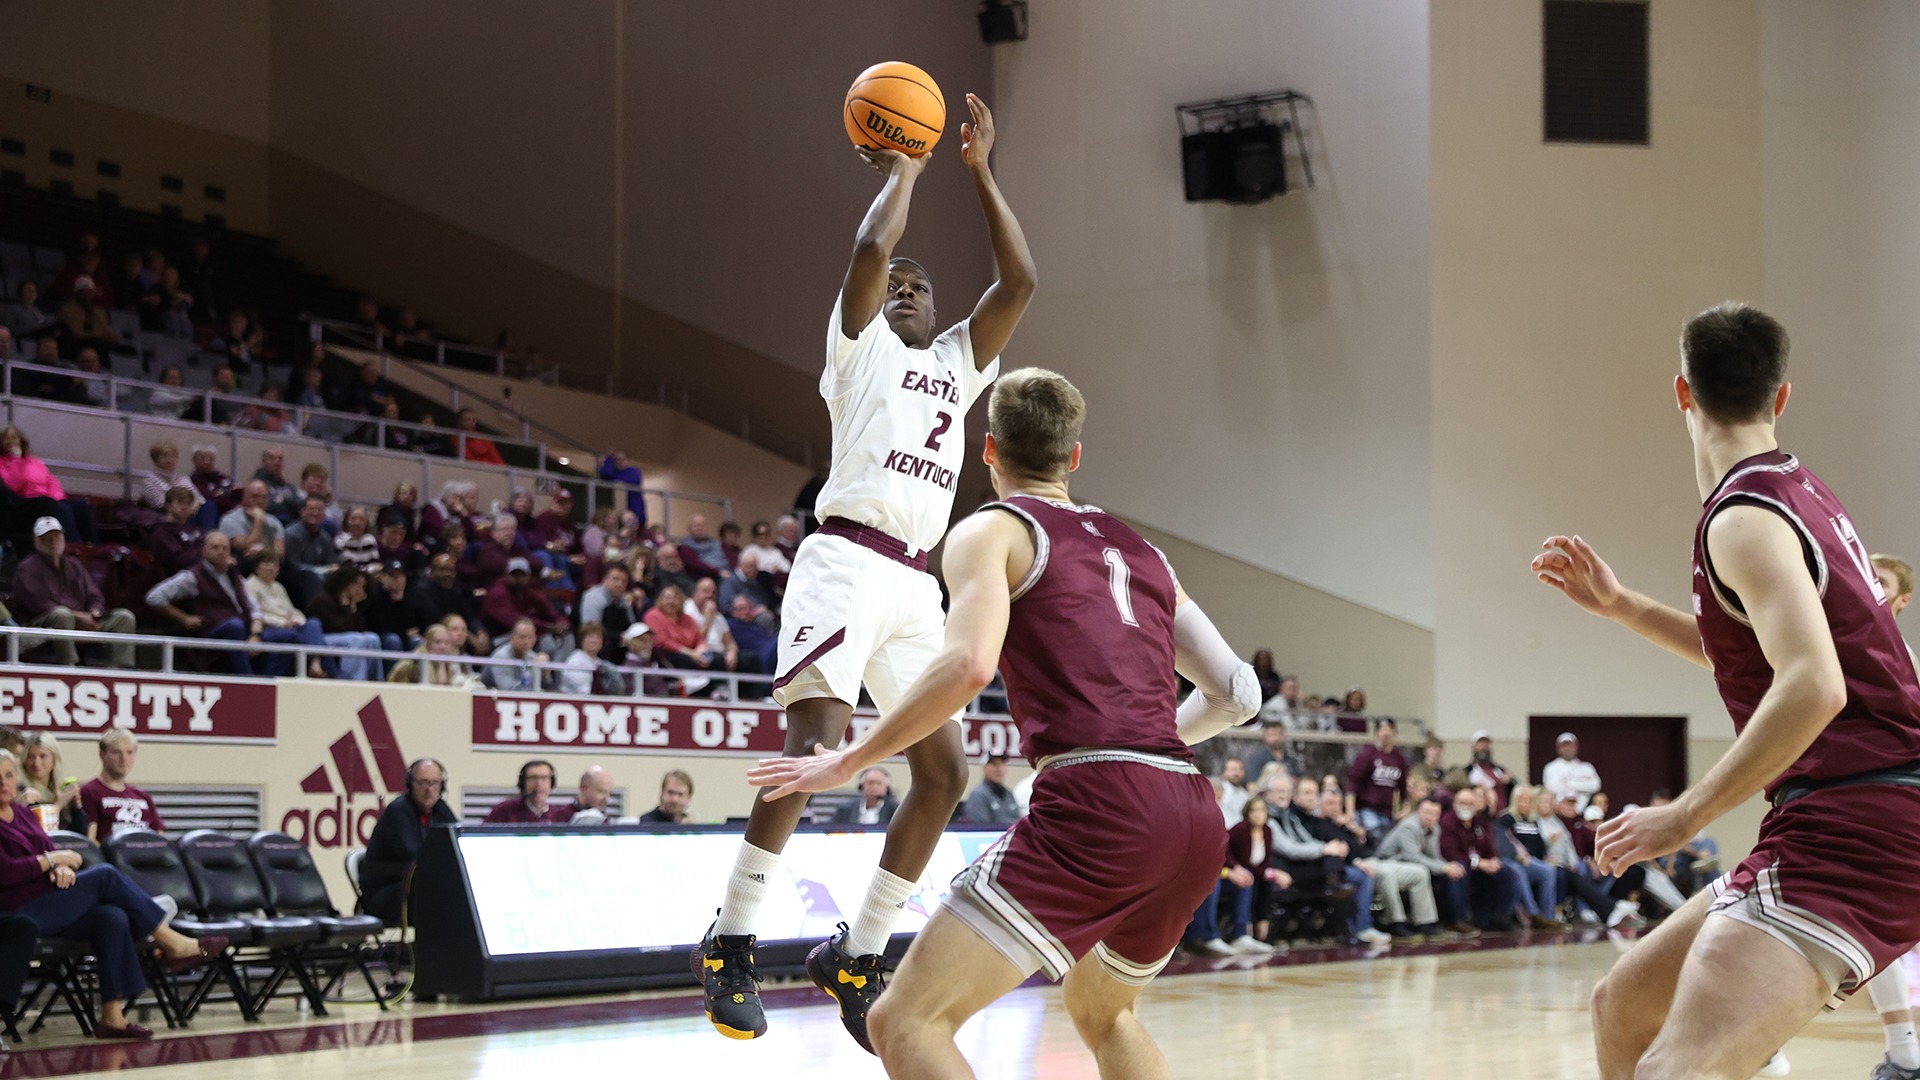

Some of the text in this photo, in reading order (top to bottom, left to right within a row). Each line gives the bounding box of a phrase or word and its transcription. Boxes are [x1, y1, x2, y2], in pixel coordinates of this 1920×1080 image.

[866, 110, 927, 150] Wilson
[901, 370, 960, 407] EASTE
[924, 410, 953, 452] 2
[883, 449, 958, 494] KENTUCK
[1102, 547, 1140, 628] 1
[791, 625, 815, 647] E
[0, 677, 222, 731] ERSITY
[495, 700, 670, 746] HOME
[691, 709, 759, 748] OF
[281, 795, 388, 849] adid
